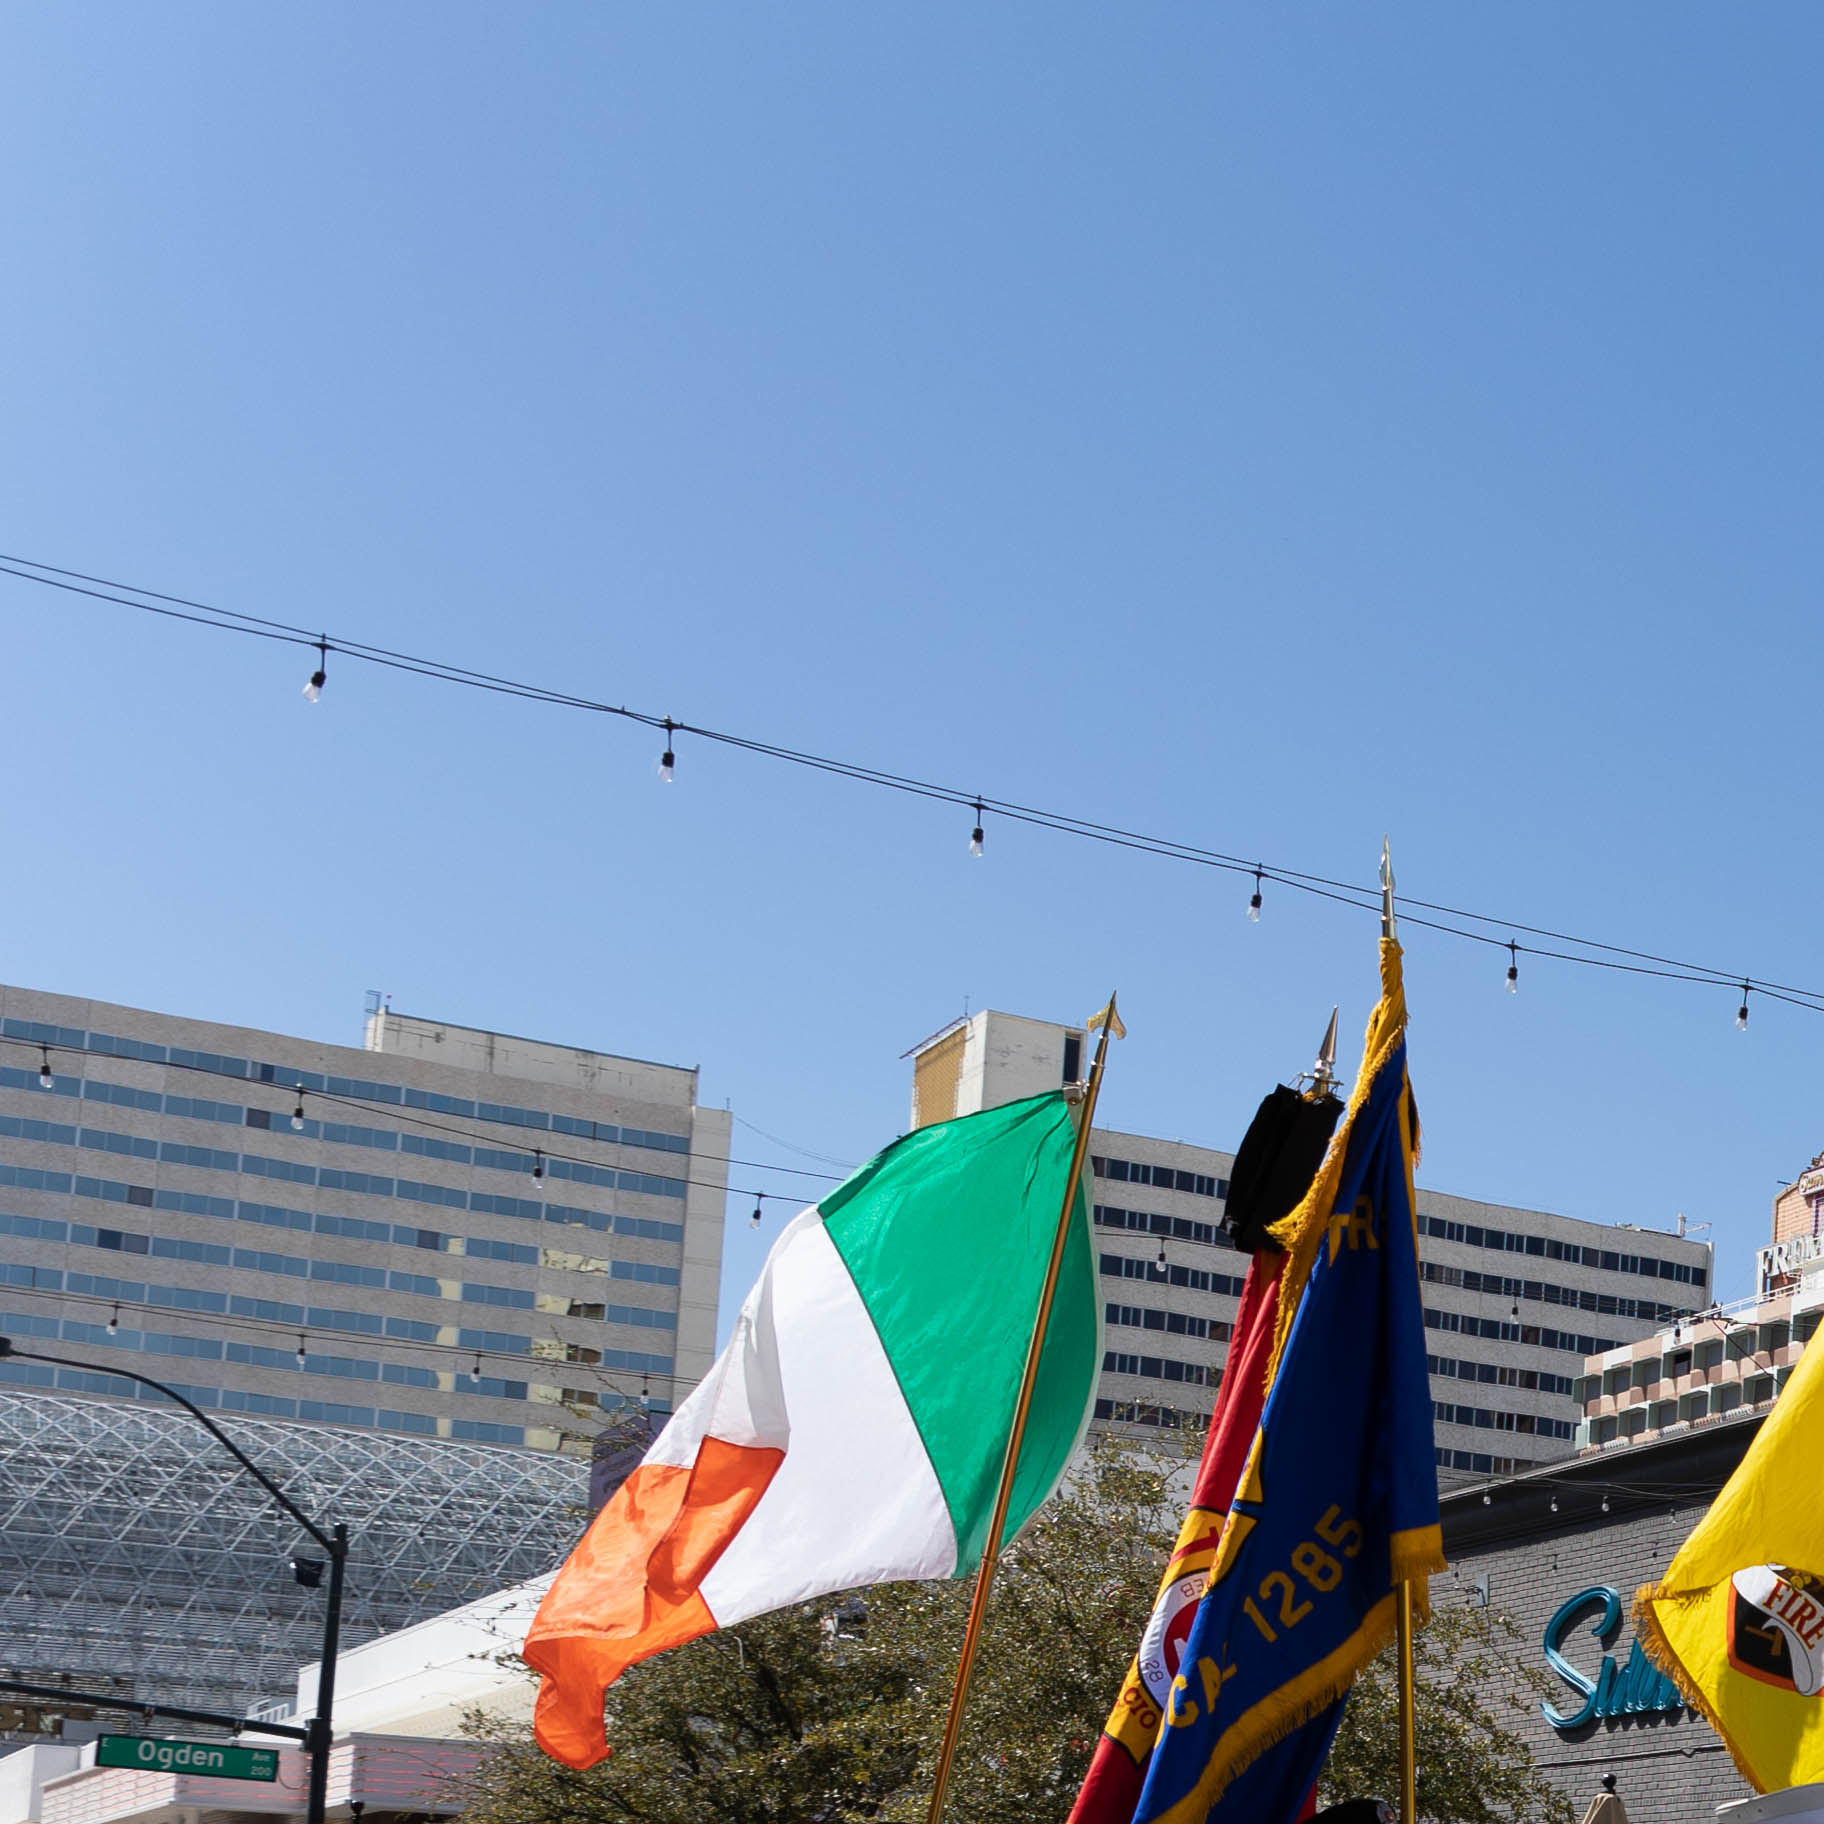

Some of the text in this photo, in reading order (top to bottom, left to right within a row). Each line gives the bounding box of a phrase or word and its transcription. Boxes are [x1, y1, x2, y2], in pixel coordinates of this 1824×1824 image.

[1242, 1503, 1365, 1644] 1285
[138, 1740, 225, 1770] Ogden
[252, 1752, 271, 1763] Ave
[250, 1765, 272, 1777] 200
